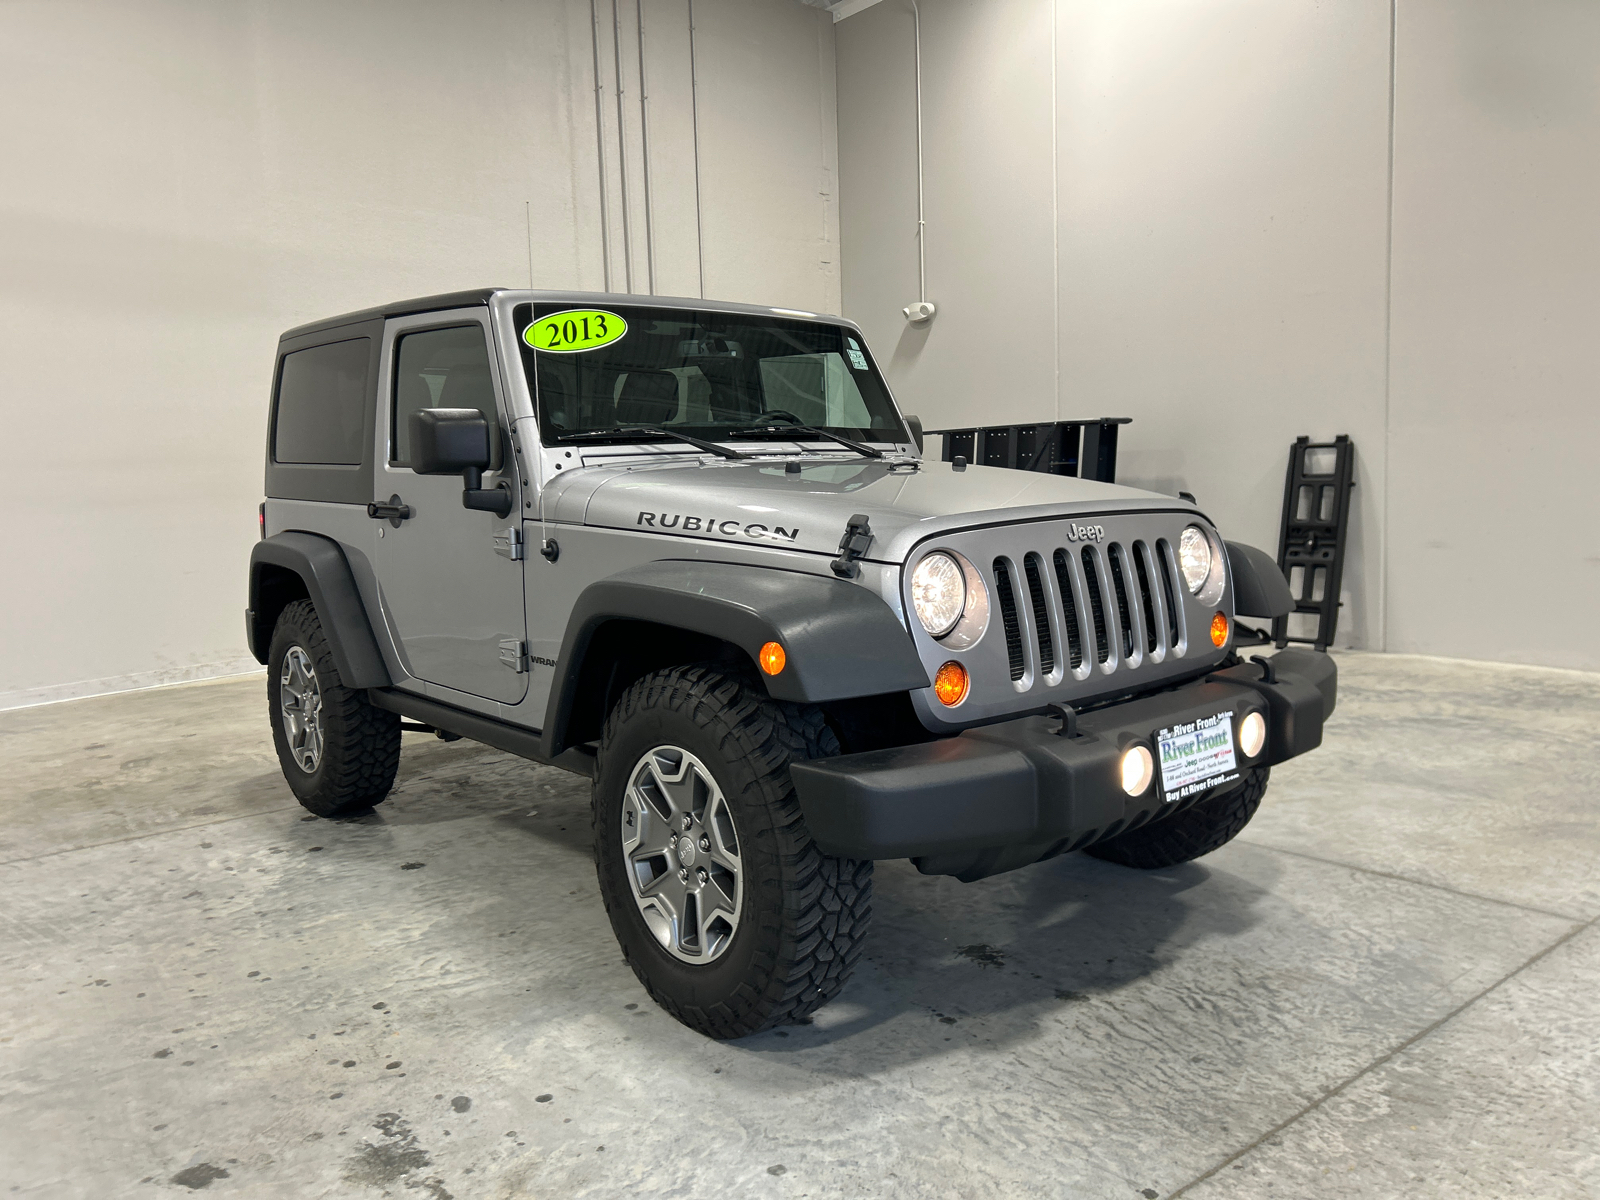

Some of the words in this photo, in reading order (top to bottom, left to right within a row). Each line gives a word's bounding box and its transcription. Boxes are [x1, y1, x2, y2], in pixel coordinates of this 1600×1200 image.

[545, 314, 608, 347] 2013
[637, 511, 800, 542] RUBICON
[1067, 523, 1105, 543] Jeep
[1173, 723, 1195, 737] River
[1162, 740, 1195, 763] River
[1195, 729, 1228, 754] Front
[1185, 759, 1197, 767] Jeep
[1166, 791, 1180, 802] Buy
[1181, 786, 1189, 797] At
[1189, 782, 1207, 794] River
